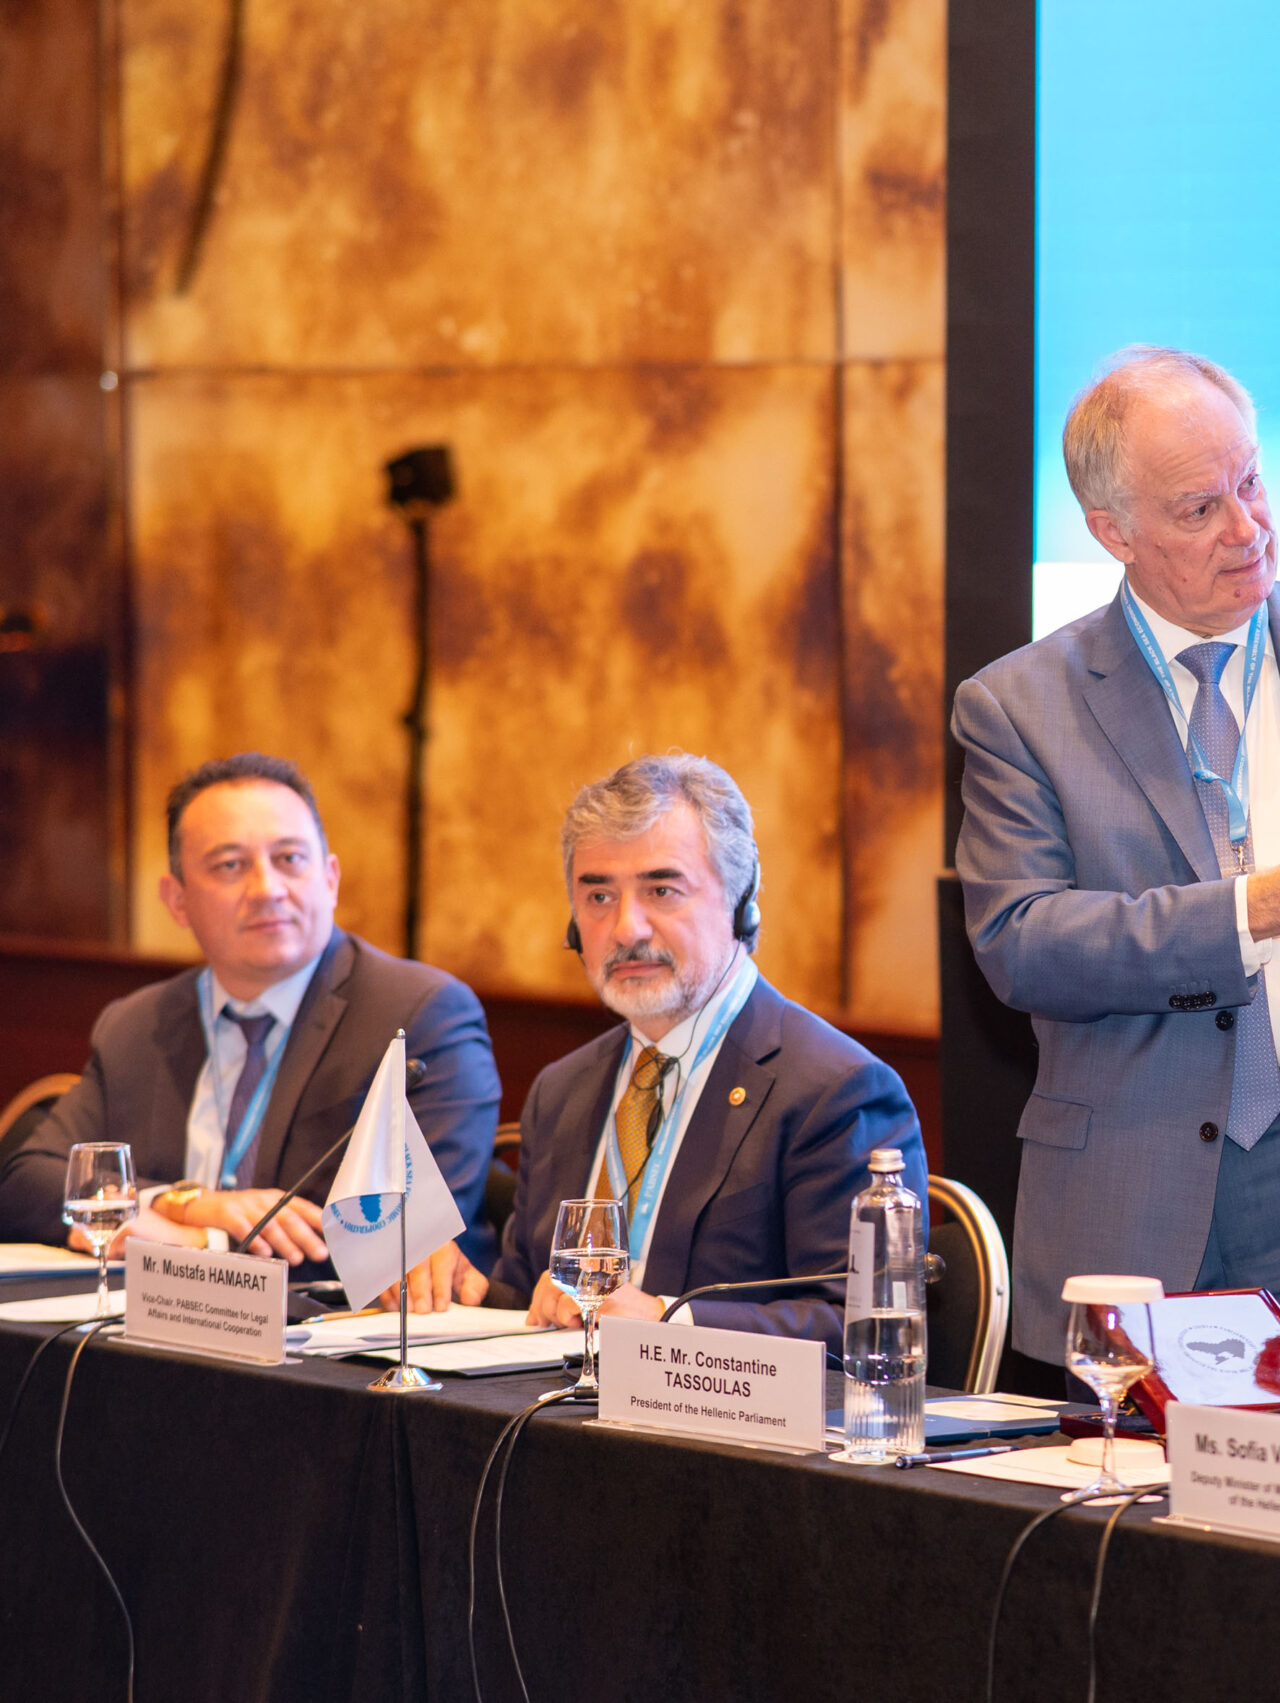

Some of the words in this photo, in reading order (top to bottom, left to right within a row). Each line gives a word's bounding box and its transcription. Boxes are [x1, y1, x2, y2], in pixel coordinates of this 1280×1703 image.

[1141, 633, 1150, 646] SEA
[1147, 645, 1160, 666] BLACK
[143, 1256, 159, 1273] Mr.
[163, 1259, 205, 1281] Mustafa
[209, 1267, 267, 1292] HAMARAT
[148, 1308, 168, 1320] Affairs
[170, 1312, 181, 1322] and
[183, 1315, 221, 1330] International
[223, 1321, 262, 1337] Cooperation
[176, 1298, 203, 1312] PABSEC
[205, 1304, 238, 1318] Committee
[240, 1310, 249, 1320] for
[251, 1311, 268, 1325] Legal
[640, 1344, 666, 1362] H.E.
[671, 1348, 690, 1365] Mr.
[695, 1351, 777, 1377] Constantine
[665, 1371, 751, 1397] TASSOULAS
[630, 1396, 671, 1412] President
[674, 1402, 683, 1413] of
[685, 1404, 698, 1415] the
[701, 1406, 736, 1420] Hellenic
[738, 1411, 786, 1427] Parliament
[1195, 1433, 1222, 1456] Ms.
[1227, 1438, 1266, 1461] Sofia
[1190, 1471, 1222, 1488] Deputy
[1239, 1496, 1253, 1508] the
